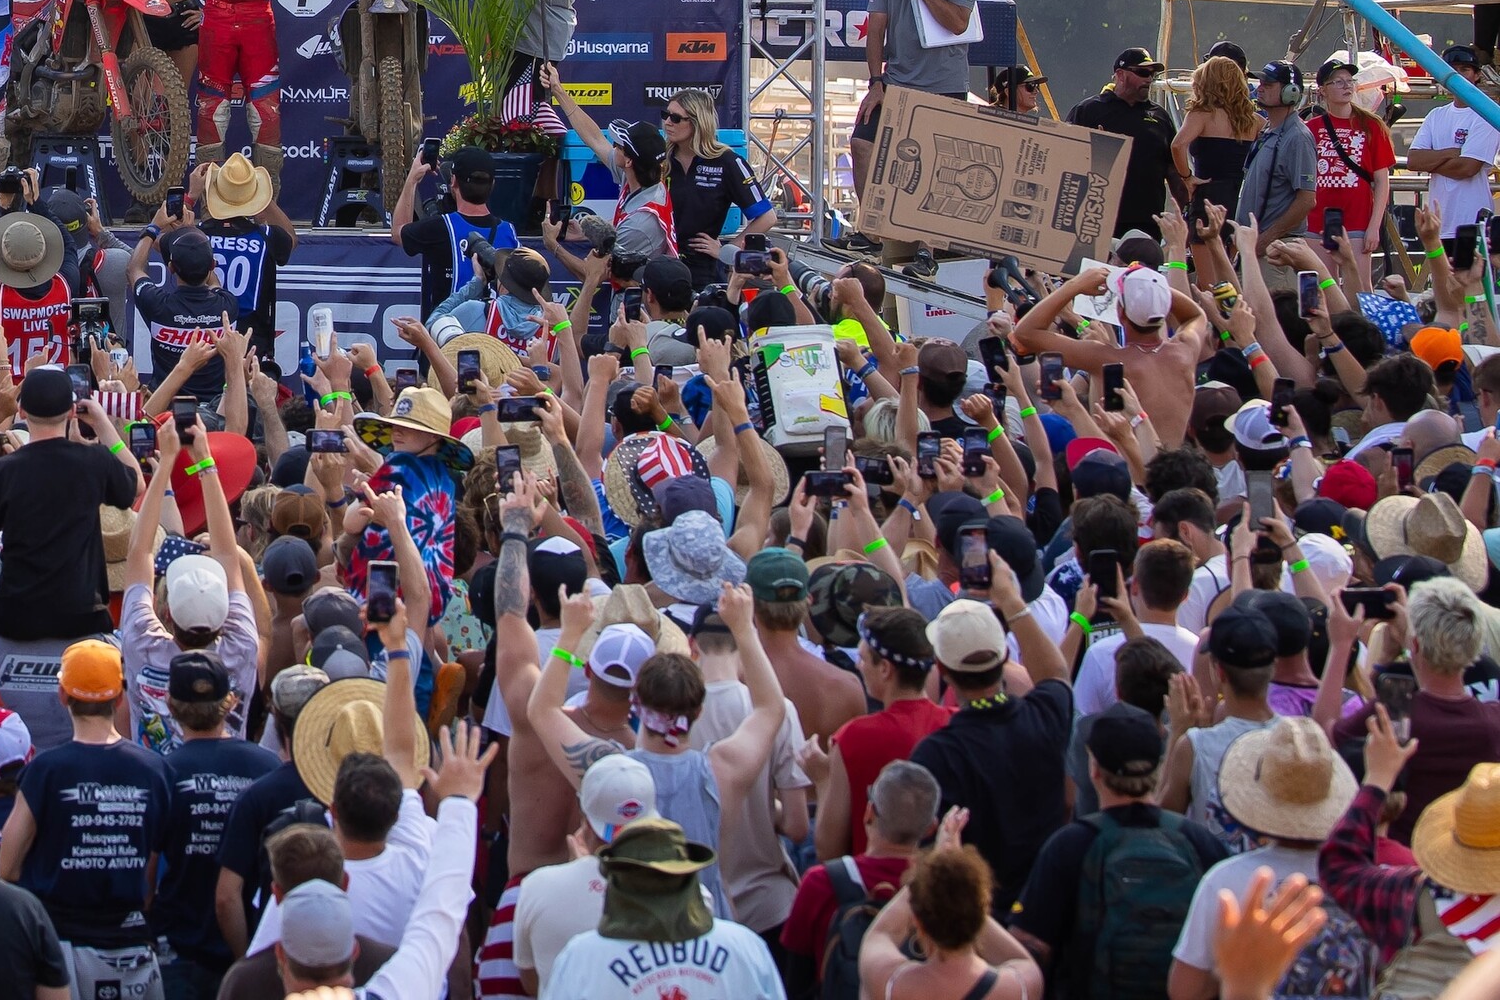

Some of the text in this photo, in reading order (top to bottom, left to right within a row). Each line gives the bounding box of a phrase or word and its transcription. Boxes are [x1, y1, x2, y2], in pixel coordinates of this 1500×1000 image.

[577, 40, 649, 56] Husqvarna
[677, 40, 716, 54] KTM
[105, 69, 122, 114] DUNLOP
[318, 166, 339, 227] UFOPLAST
[1054, 173, 1072, 230] DISPLAY BOARD
[1062, 179, 1081, 227] TRIFOLD
[23, 320, 49, 332] LIVE
[608, 936, 730, 987] REDBUD
